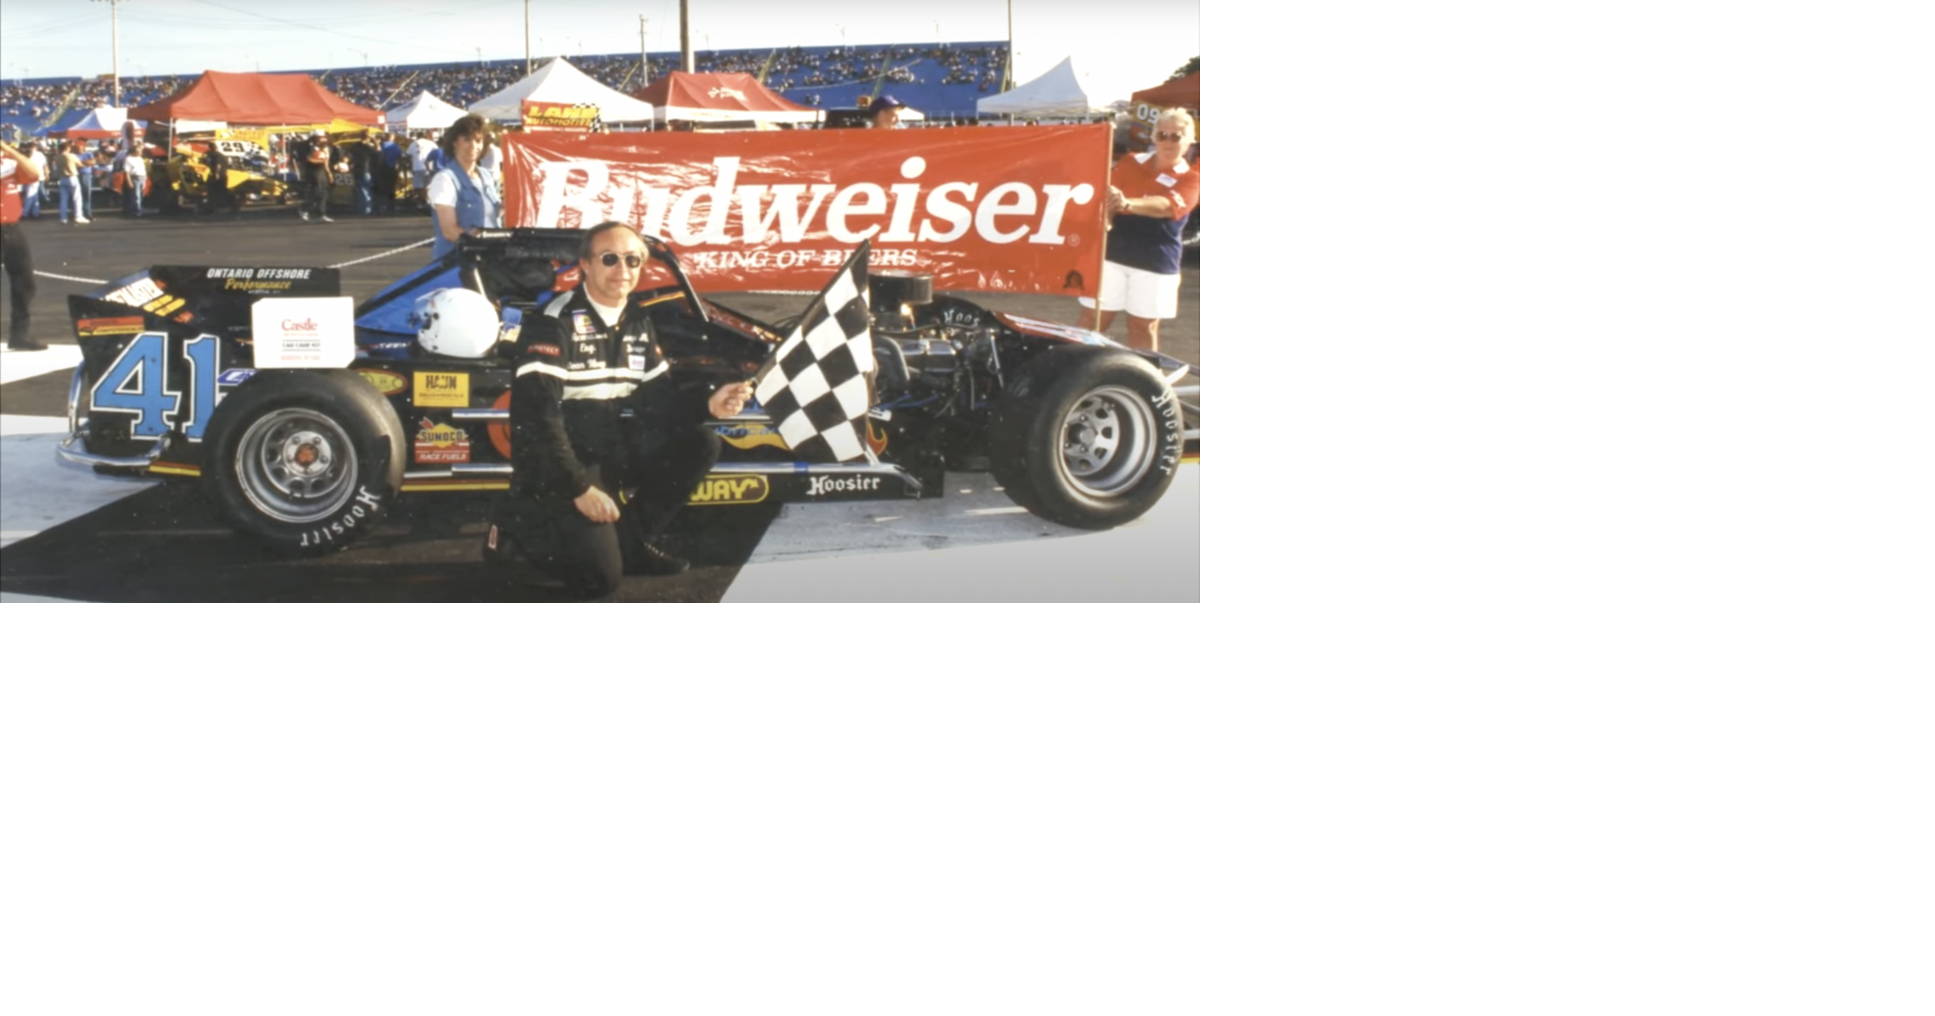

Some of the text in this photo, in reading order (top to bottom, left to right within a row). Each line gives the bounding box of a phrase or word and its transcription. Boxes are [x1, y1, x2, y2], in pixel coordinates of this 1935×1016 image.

[221, 141, 245, 152] 29
[534, 156, 1095, 247] Budweiser
[697, 249, 918, 268] KING OF BERS
[206, 268, 311, 280] ONTARIO OFFSHORE
[225, 278, 291, 290] Performance
[281, 317, 318, 331] Castle
[944, 307, 980, 327] Hoos
[90, 331, 221, 443] 41
[421, 431, 463, 442] SUNOCO
[419, 453, 467, 461] RACE FUELS
[689, 478, 759, 502] WAY
[806, 473, 881, 495] Hoosier
[300, 485, 381, 547] Hoosier
